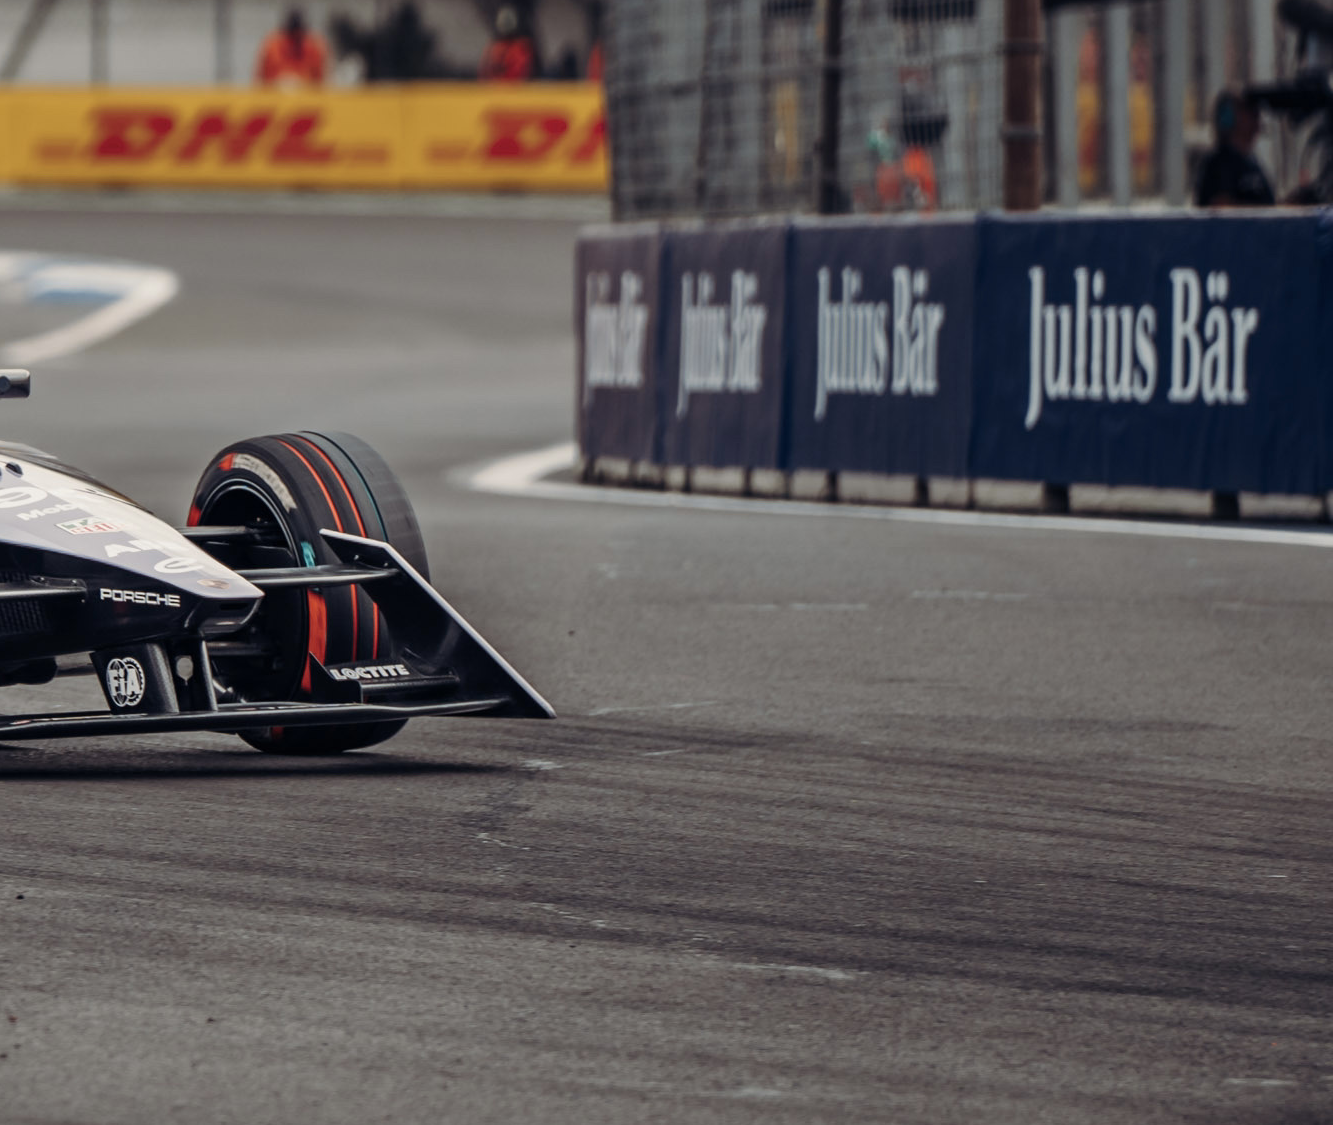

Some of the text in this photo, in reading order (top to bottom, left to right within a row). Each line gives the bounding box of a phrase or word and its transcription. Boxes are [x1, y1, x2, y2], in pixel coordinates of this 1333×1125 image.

[86, 105, 336, 167] DHL
[677, 270, 731, 419] Julius
[814, 266, 945, 420] Julius Bär
[1024, 266, 1258, 430] Julius Bär
[99, 588, 181, 607] PORSCHE
[329, 663, 411, 681] LOCTITE
